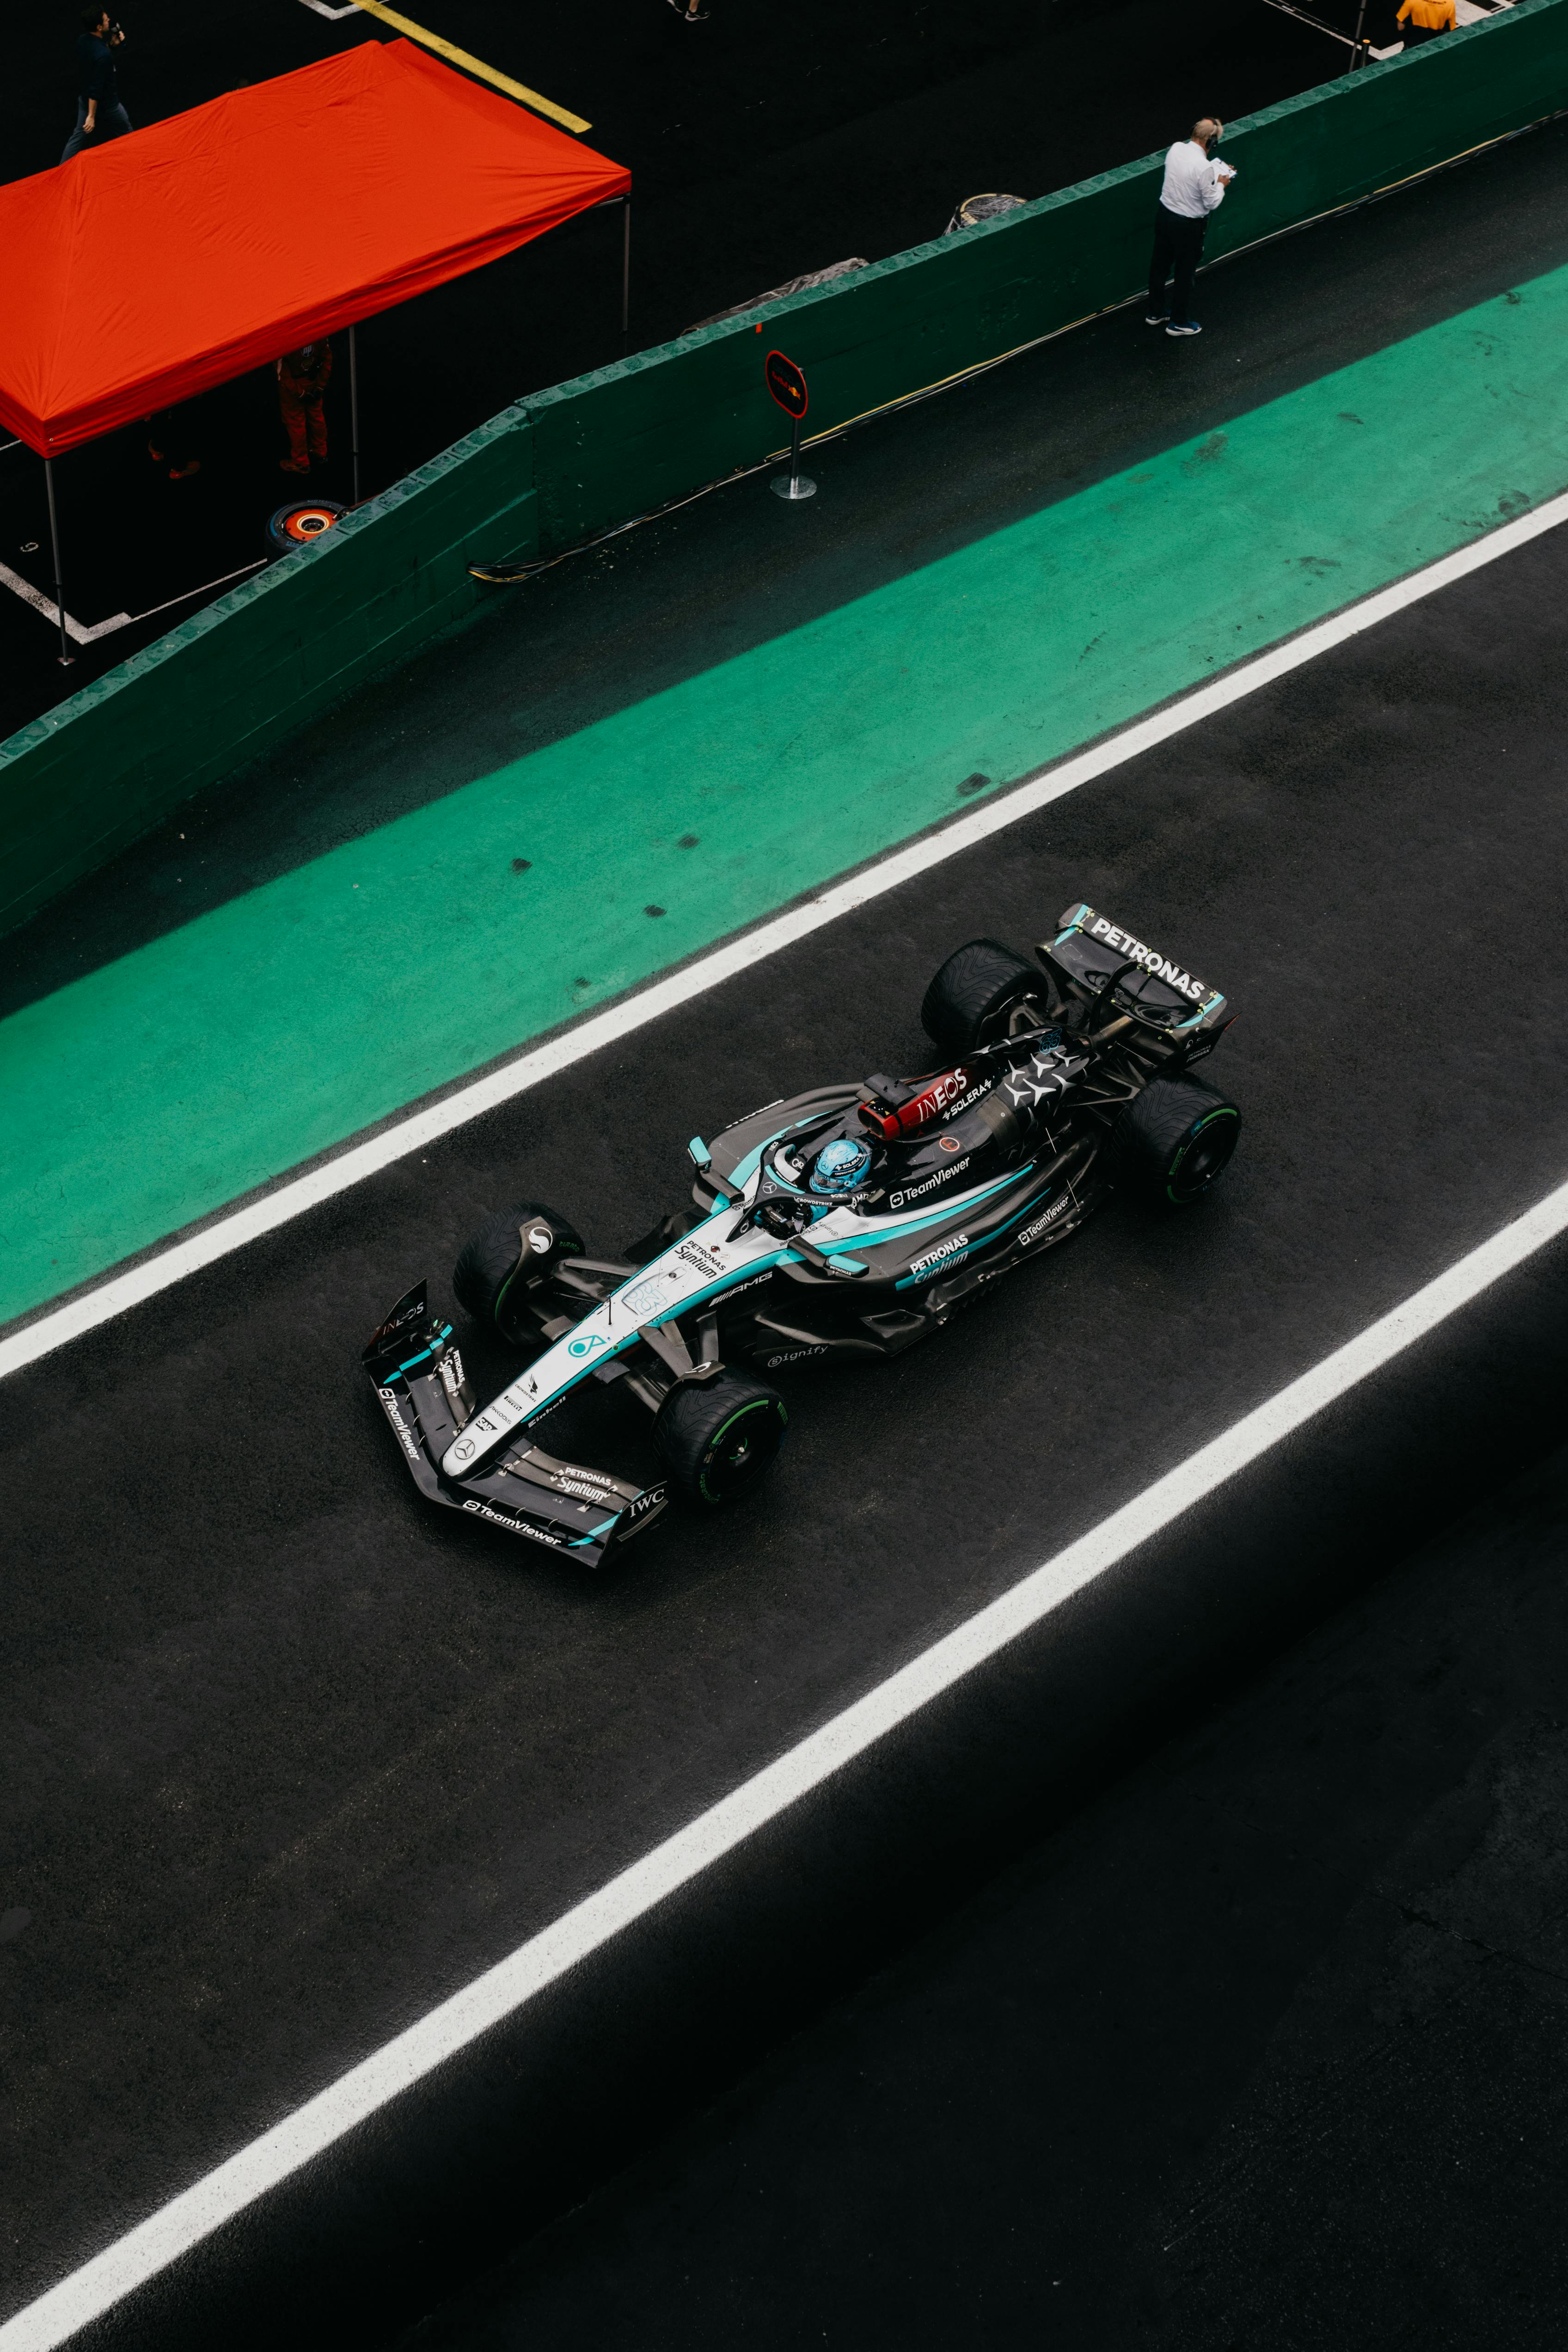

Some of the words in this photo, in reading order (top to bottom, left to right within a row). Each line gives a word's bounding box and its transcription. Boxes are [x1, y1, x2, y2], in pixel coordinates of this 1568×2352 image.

[1091, 918, 1205, 998] PETRONAS
[1039, 1028, 1062, 1054] 63
[917, 1068, 967, 1122] INEOS
[950, 1084, 986, 1116] SOLERA
[768, 1141, 779, 1152] INEOS
[792, 1158, 804, 1170] G42
[842, 1157, 860, 1169] SOLERA
[903, 1157, 970, 1201] TeamViewer
[796, 1198, 833, 1206] CROWDSTRIKE
[1027, 1196, 1069, 1237] TeamViewer
[674, 1245, 717, 1279] Syntium
[686, 1240, 726, 1271] PETRONAS
[910, 1234, 969, 1274] PETRONAS
[830, 1266, 852, 1276] PETRONAS
[622, 1280, 668, 1317] 63
[453, 1349, 465, 1383] PETRONAS
[767, 1346, 828, 1367] signify
[439, 1359, 457, 1393] Syntium
[504, 1395, 522, 1412] PIRELLI
[514, 1384, 537, 1403] CROWDSTRIKE
[476, 1418, 493, 1431] SAP
[528, 1395, 566, 1428] Einhell
[385, 1398, 420, 1460] TeamViewer
[557, 1476, 606, 1501] Syntium
[565, 1467, 612, 1486] PETRONAS
[630, 1488, 665, 1518] IWC
[479, 1505, 562, 1545] TeamViewer
